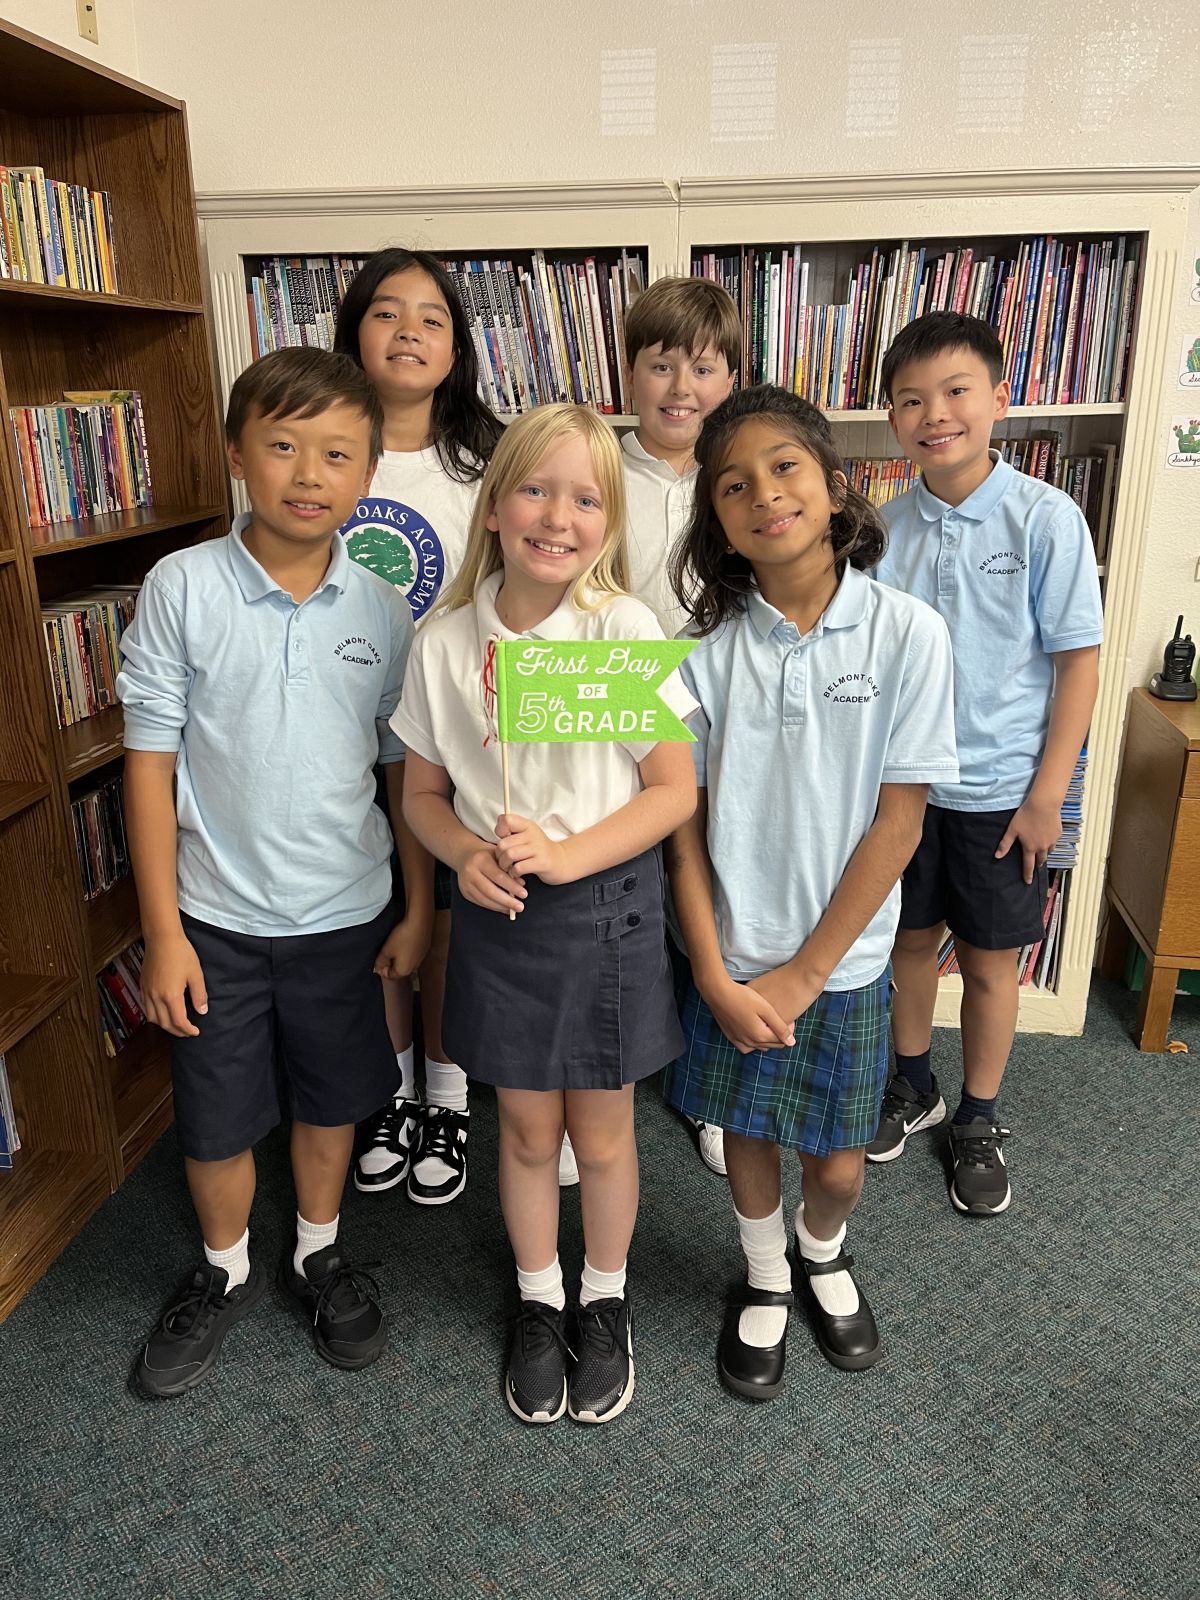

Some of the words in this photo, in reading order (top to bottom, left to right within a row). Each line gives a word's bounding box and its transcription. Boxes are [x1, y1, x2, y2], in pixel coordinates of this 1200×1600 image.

[136, 399, 148, 446] THREE
[143, 449, 153, 486] KEYS
[356, 505, 408, 525] OAKS
[411, 528, 438, 611] ACADEM
[979, 552, 1014, 570] BELMONT
[334, 637, 366, 656] BELMONT
[368, 642, 382, 664] OAKS
[342, 655, 374, 666] ACADEMY
[516, 646, 588, 676] First
[595, 647, 662, 680] Day
[584, 686, 601, 697] OF
[824, 674, 866, 698] BELMONT
[516, 692, 566, 734] 5th
[554, 710, 658, 734] GRADE
